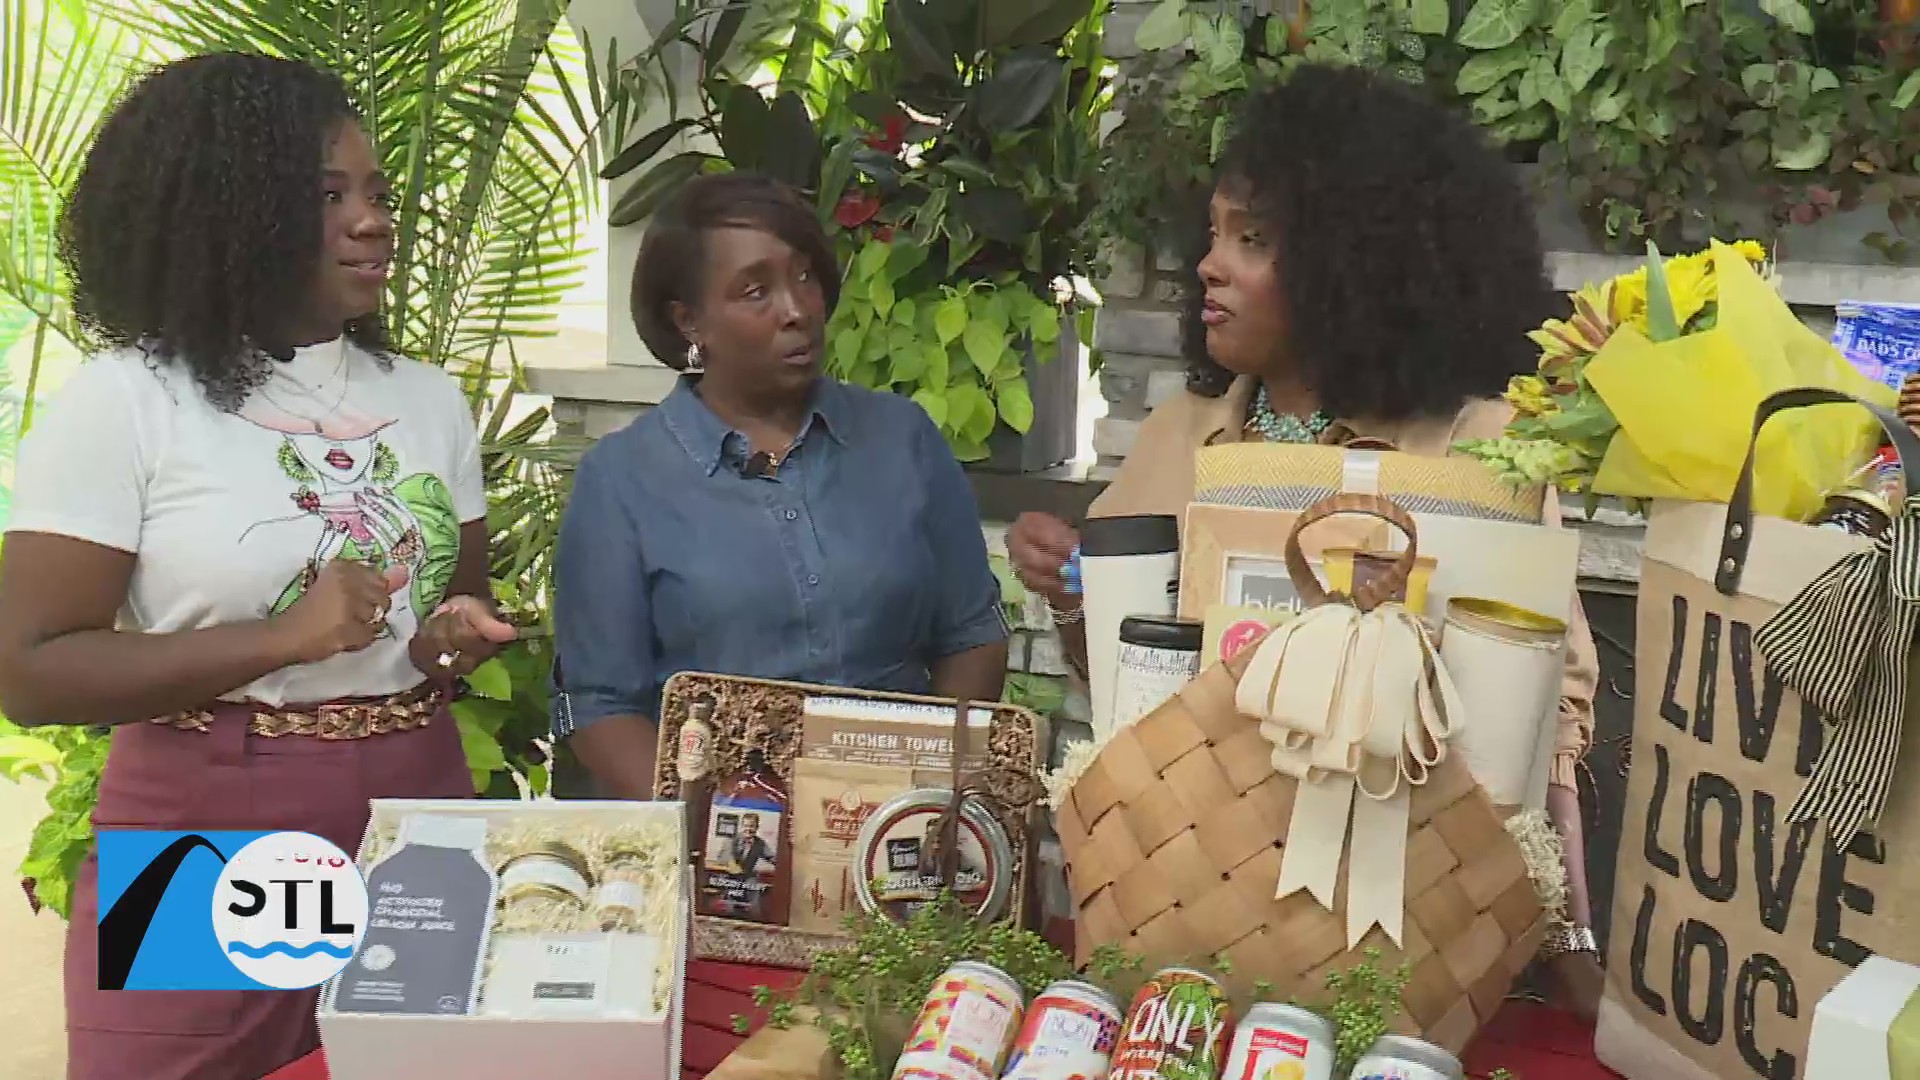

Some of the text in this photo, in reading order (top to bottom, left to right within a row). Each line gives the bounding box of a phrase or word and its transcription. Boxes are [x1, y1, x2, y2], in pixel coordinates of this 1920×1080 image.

[831, 731, 898, 749] KITCHEN
[1644, 744, 1886, 968] LOVE
[1127, 994, 1226, 1063] ONLY
